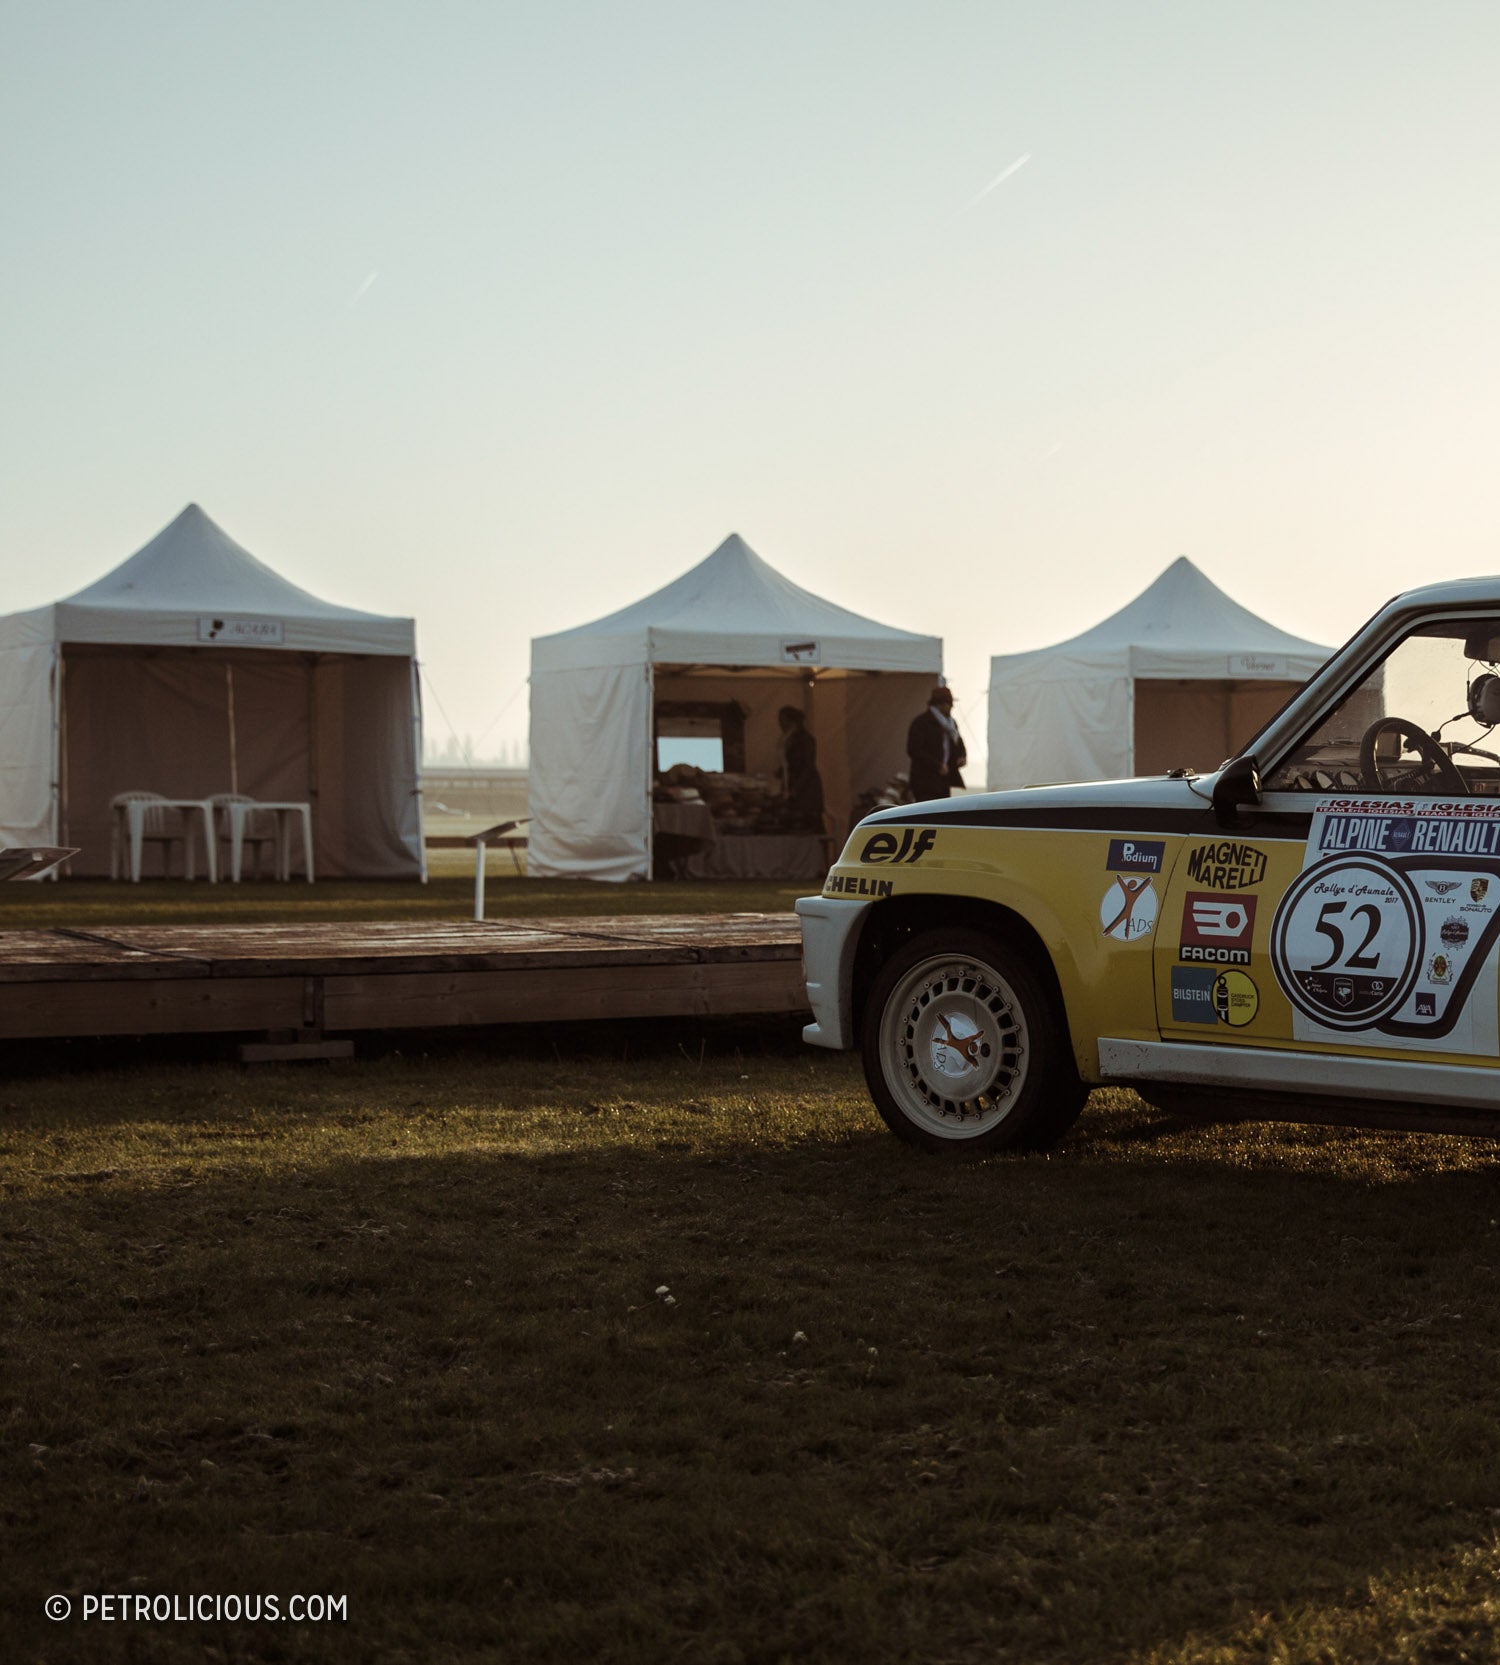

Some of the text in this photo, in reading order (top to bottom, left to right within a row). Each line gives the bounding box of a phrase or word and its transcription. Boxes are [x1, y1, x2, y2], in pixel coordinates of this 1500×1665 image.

[1329, 799, 1416, 810] IGLESIAS
[1322, 817, 1392, 851] ALPINE
[860, 828, 937, 864] elf
[1424, 896, 1457, 904] BENTLEY
[1310, 901, 1382, 971] 52
[1181, 946, 1249, 963] FACOM
[1173, 988, 1211, 1002] BILSTEIN
